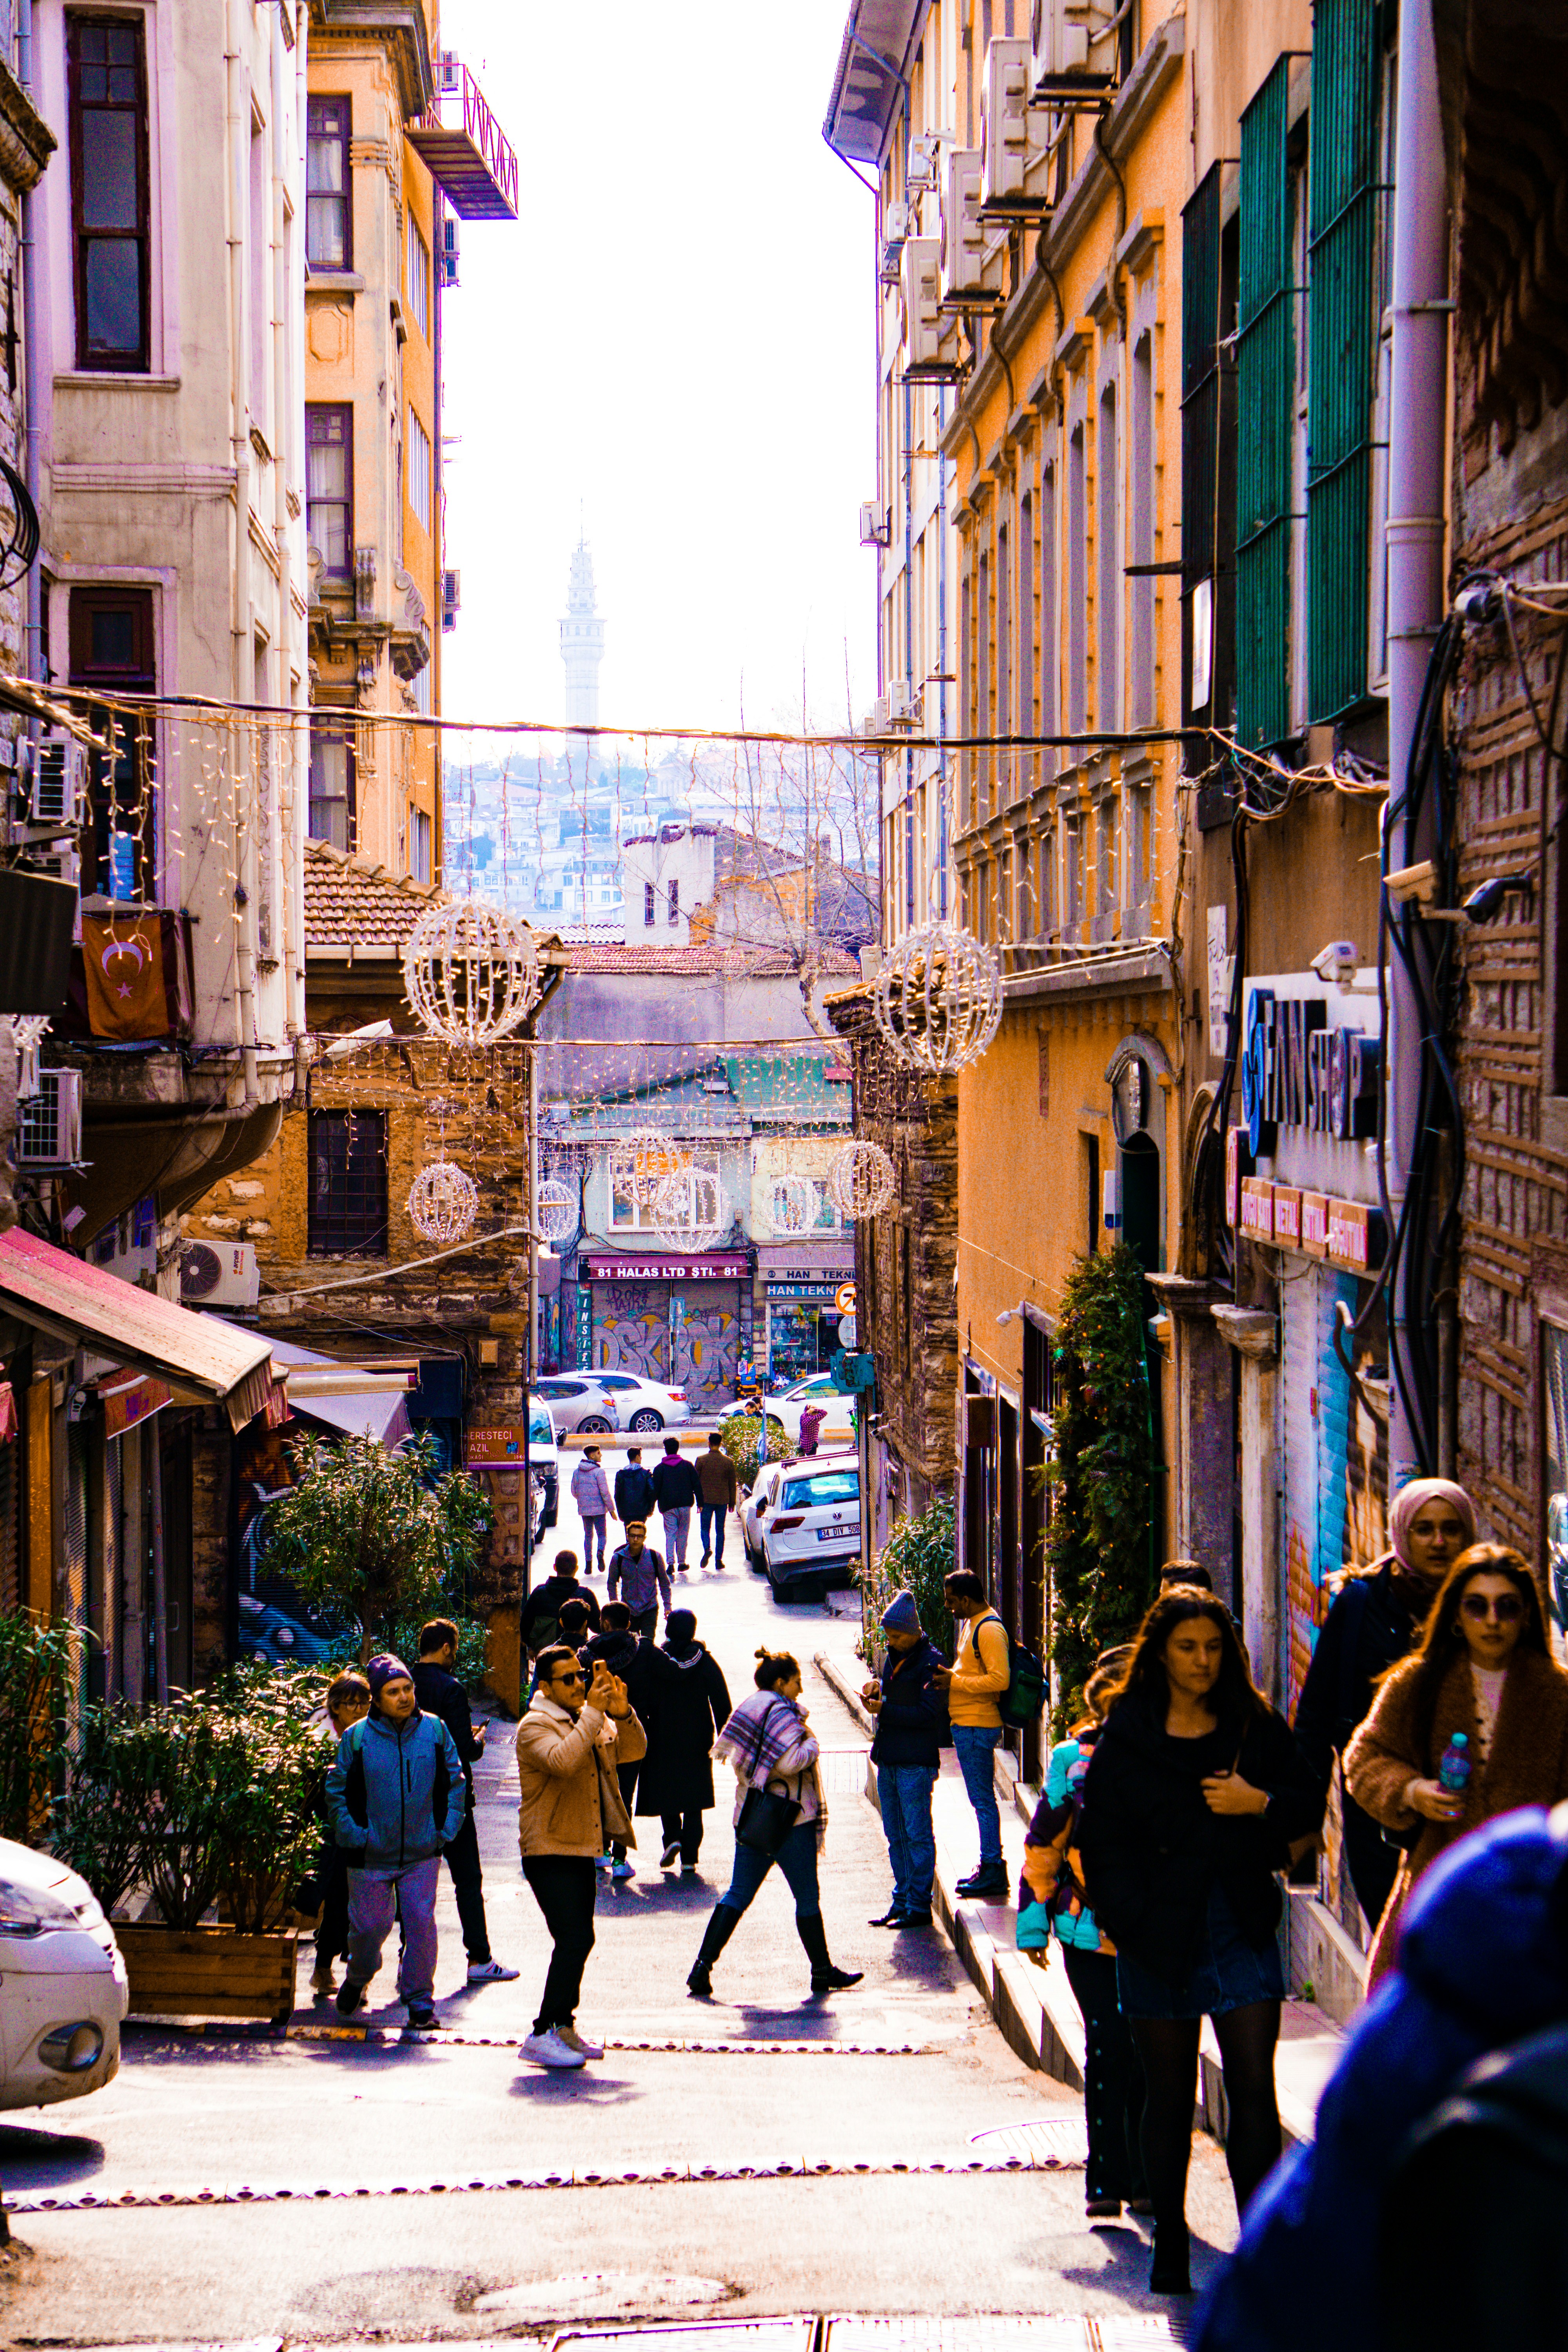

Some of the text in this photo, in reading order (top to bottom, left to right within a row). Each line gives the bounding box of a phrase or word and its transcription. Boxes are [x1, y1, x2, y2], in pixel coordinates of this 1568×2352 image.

[598, 1267, 610, 1277] 81
[617, 1268, 659, 1277] HALAS
[662, 1267, 685, 1277] LTD
[724, 1267, 737, 1276] 81
[767, 1286, 795, 1295] HAN
